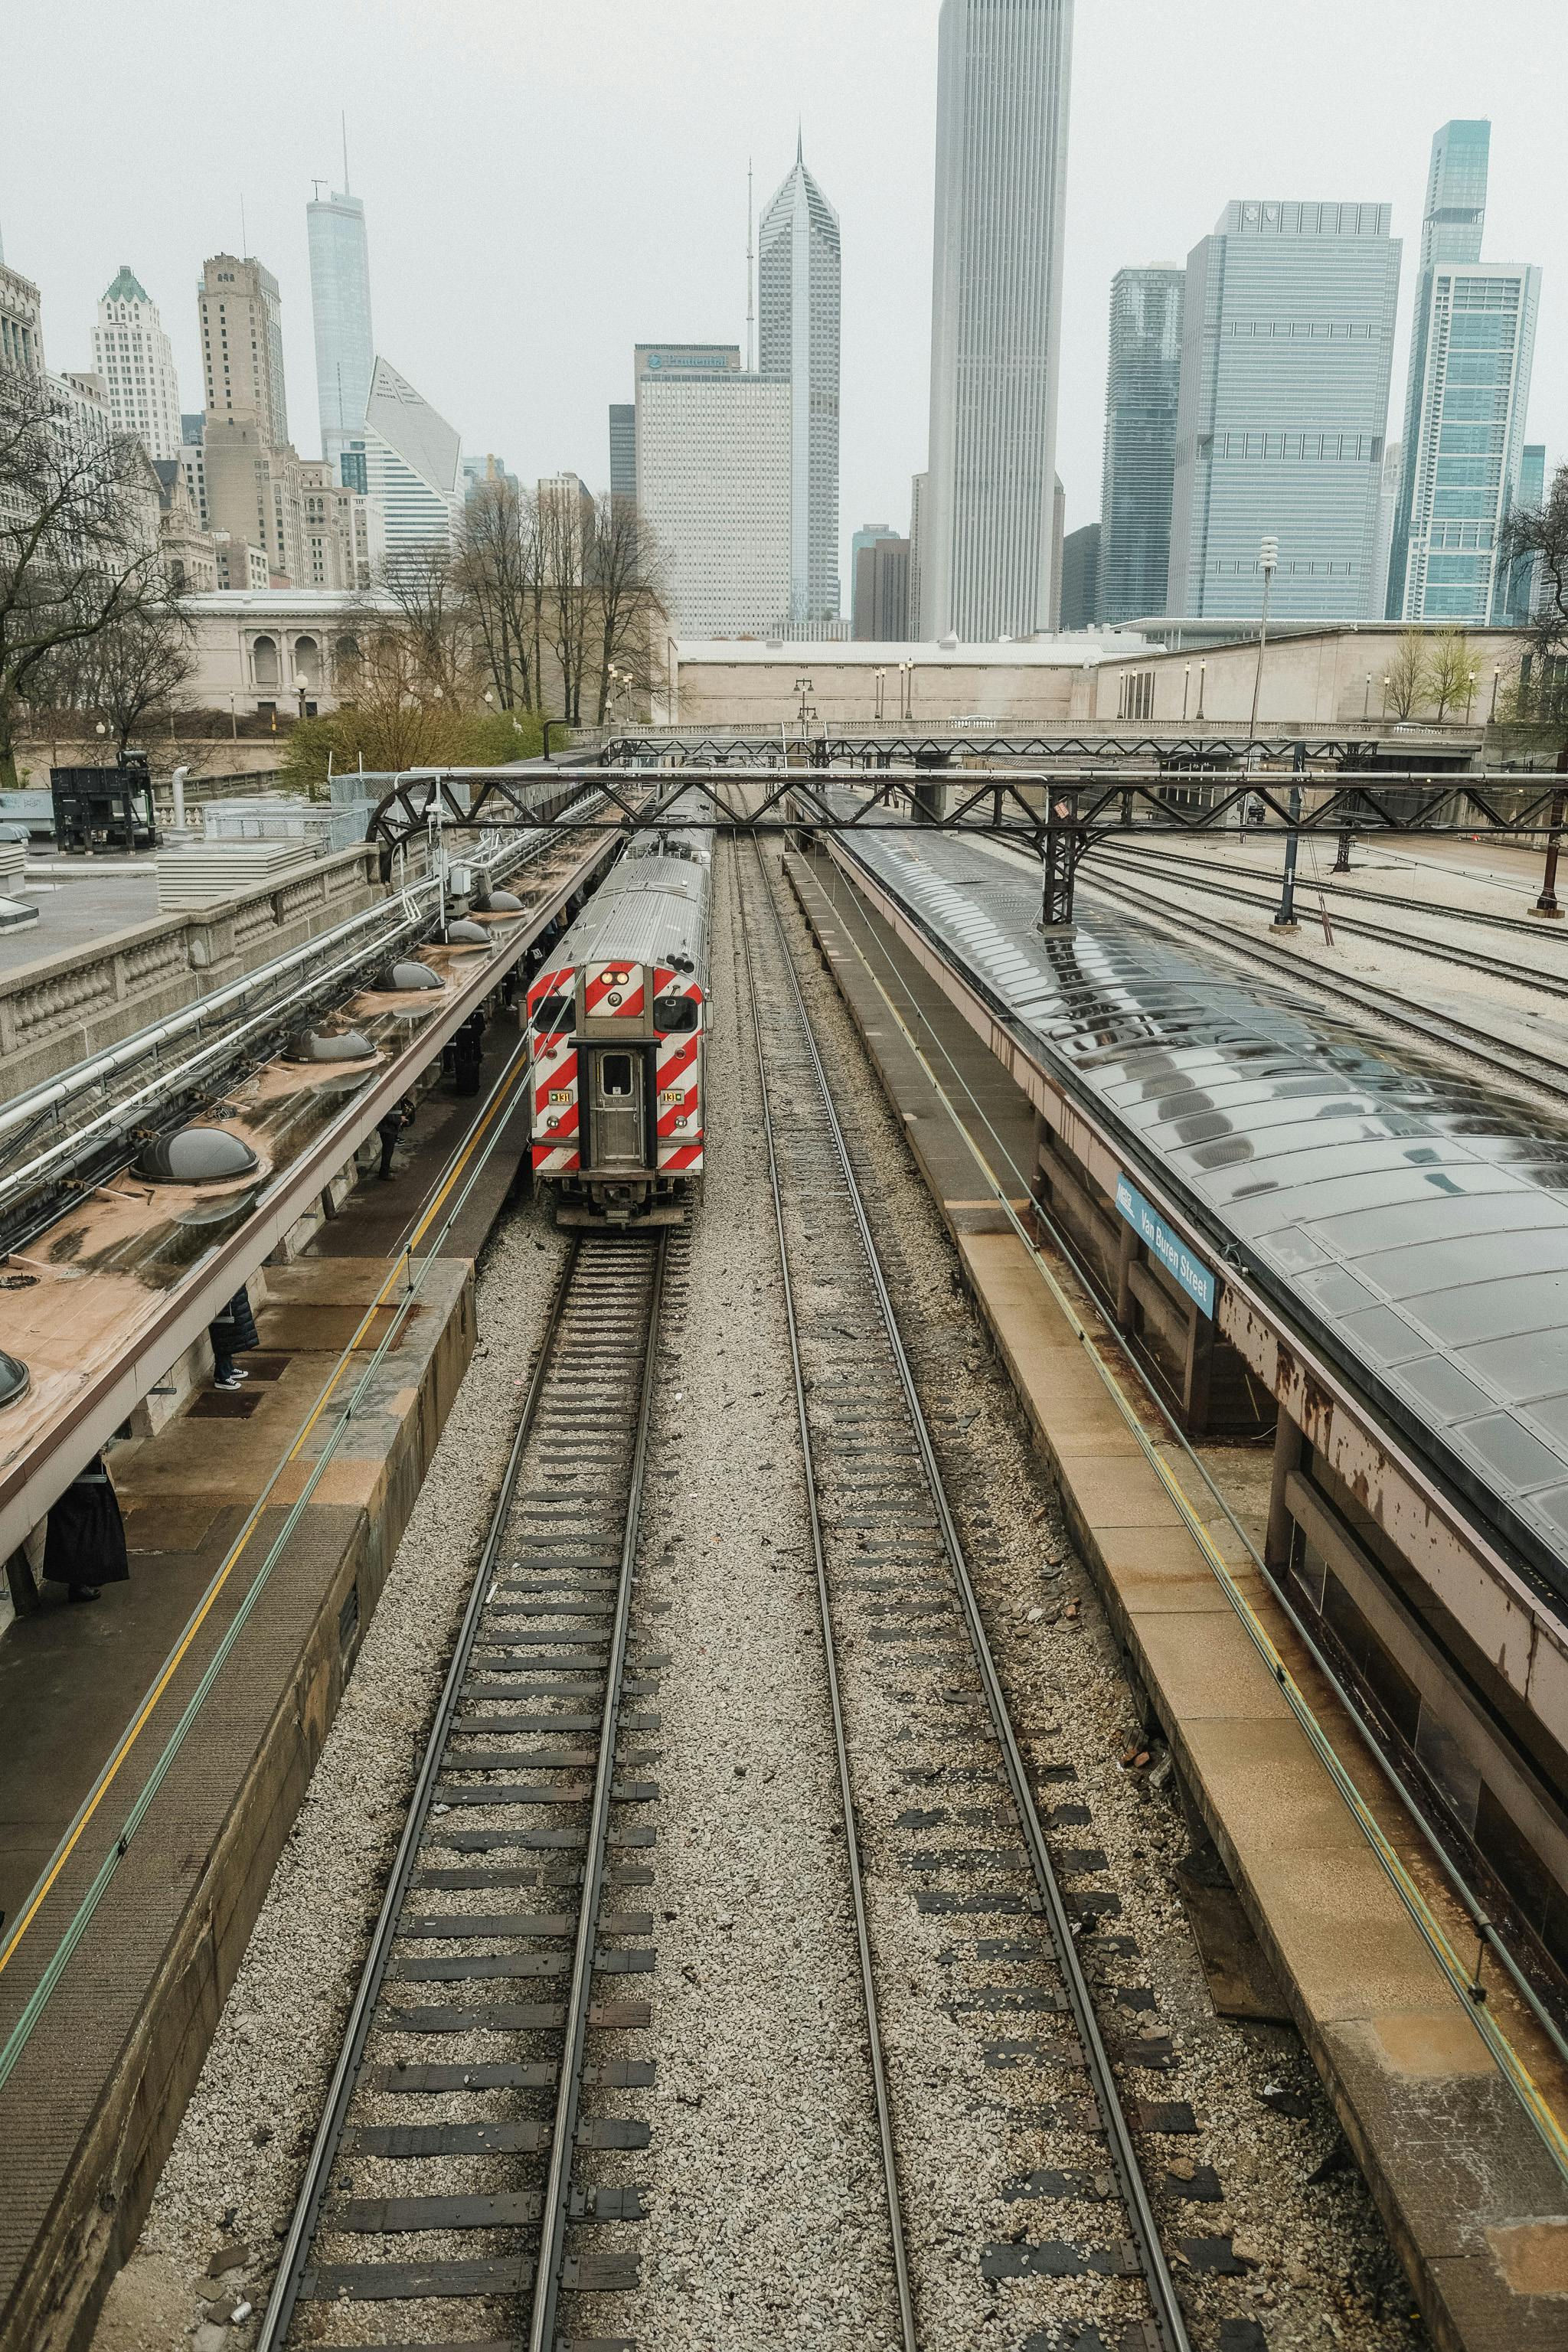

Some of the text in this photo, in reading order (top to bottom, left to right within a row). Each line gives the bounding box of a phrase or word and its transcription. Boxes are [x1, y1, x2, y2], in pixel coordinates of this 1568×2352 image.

[557, 1093, 569, 1102] 131
[665, 1093, 676, 1102] 131
[1142, 1209, 1207, 1302] Van Buren Street
